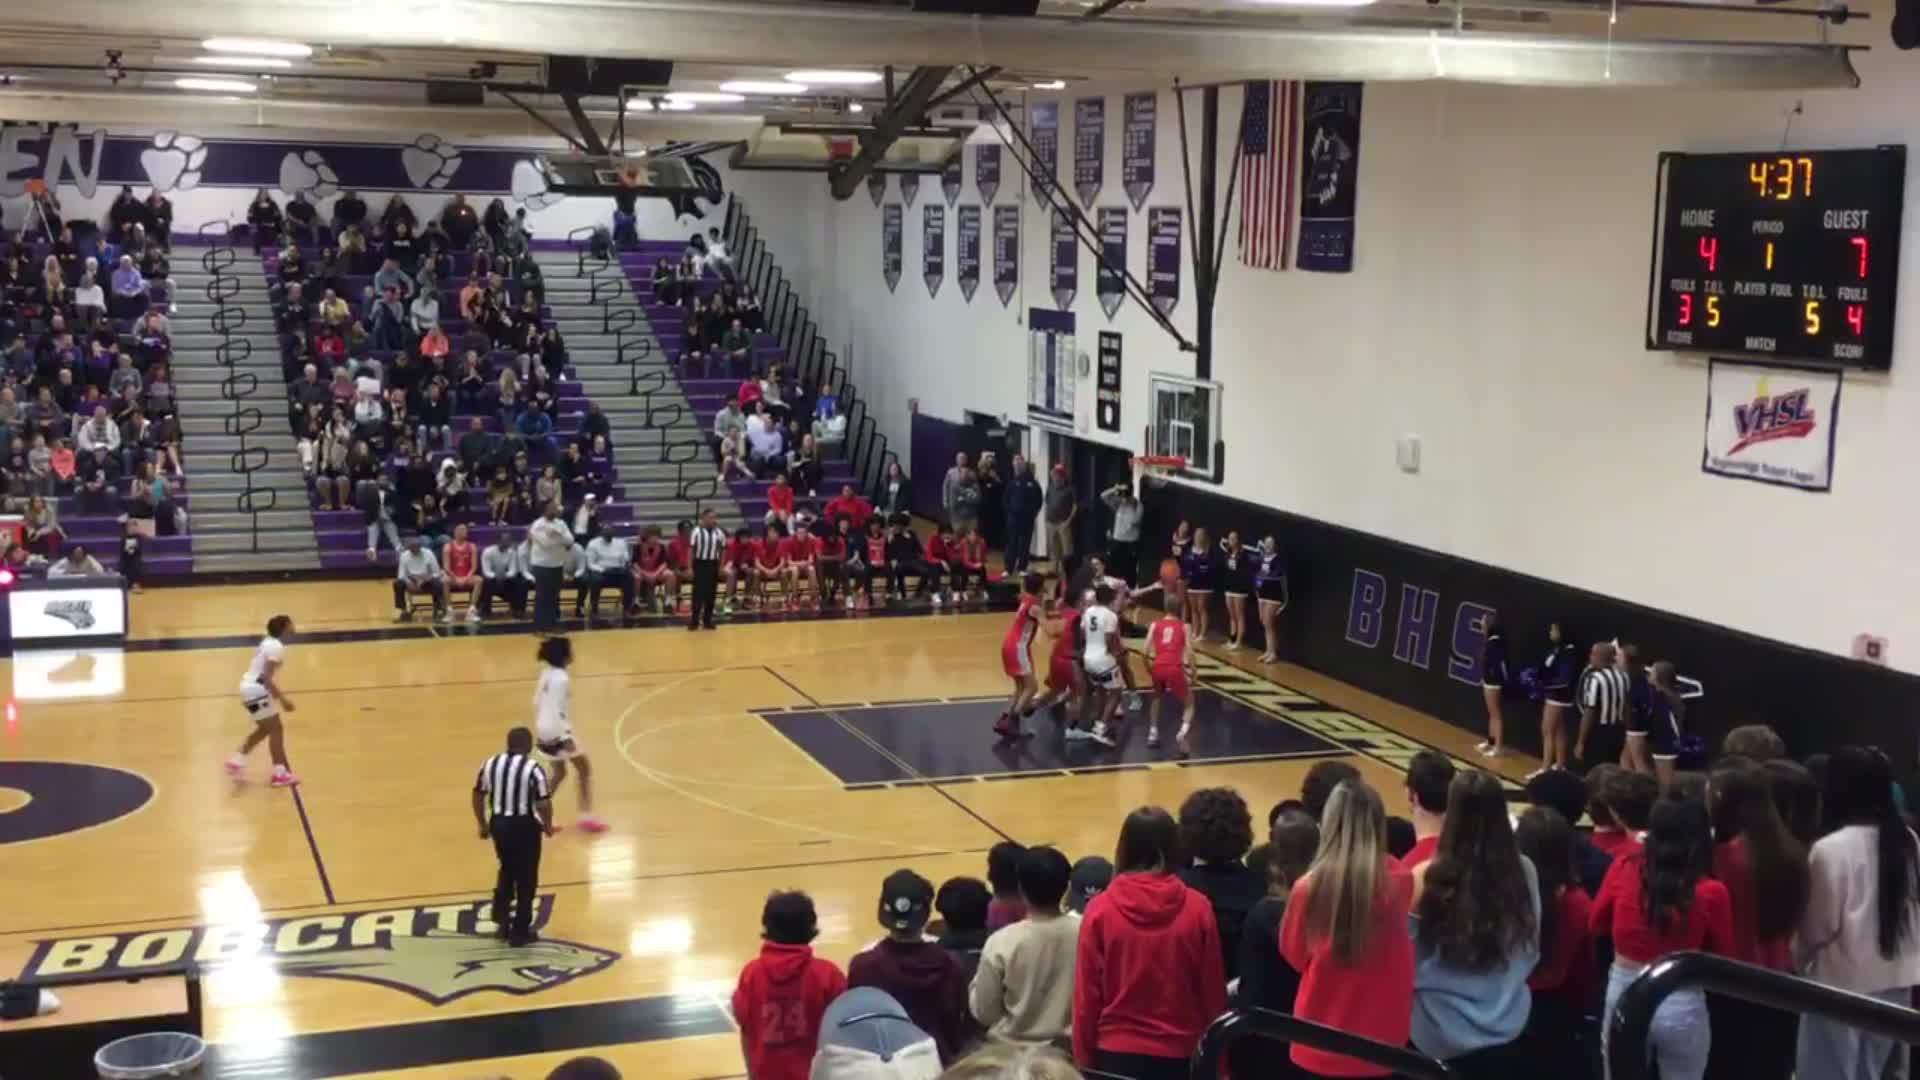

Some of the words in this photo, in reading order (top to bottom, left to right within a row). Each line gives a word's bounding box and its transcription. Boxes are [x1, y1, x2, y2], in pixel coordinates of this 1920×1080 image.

[1749, 158, 1813, 199] 4:37
[1680, 209, 1716, 227] HOME
[1752, 220, 1785, 234] PERIOD
[1823, 210, 1869, 229] GUEST
[1700, 236, 1716, 271] 4
[1765, 243, 1774, 270] 1
[1851, 237, 1868, 278] 7
[1733, 281, 1767, 296] PLAYER
[1771, 283, 1793, 297] FOUL
[1838, 287, 1868, 301] FOULS
[1679, 293, 1692, 325] 3
[1707, 295, 1720, 327] 5
[1806, 301, 1820, 336] 5
[1848, 305, 1863, 335] 4
[1745, 335, 1777, 351] MATCH
[1733, 387, 1816, 439] VHSL
[1089, 616, 1099, 633] 5
[1345, 569, 1496, 686] BHS
